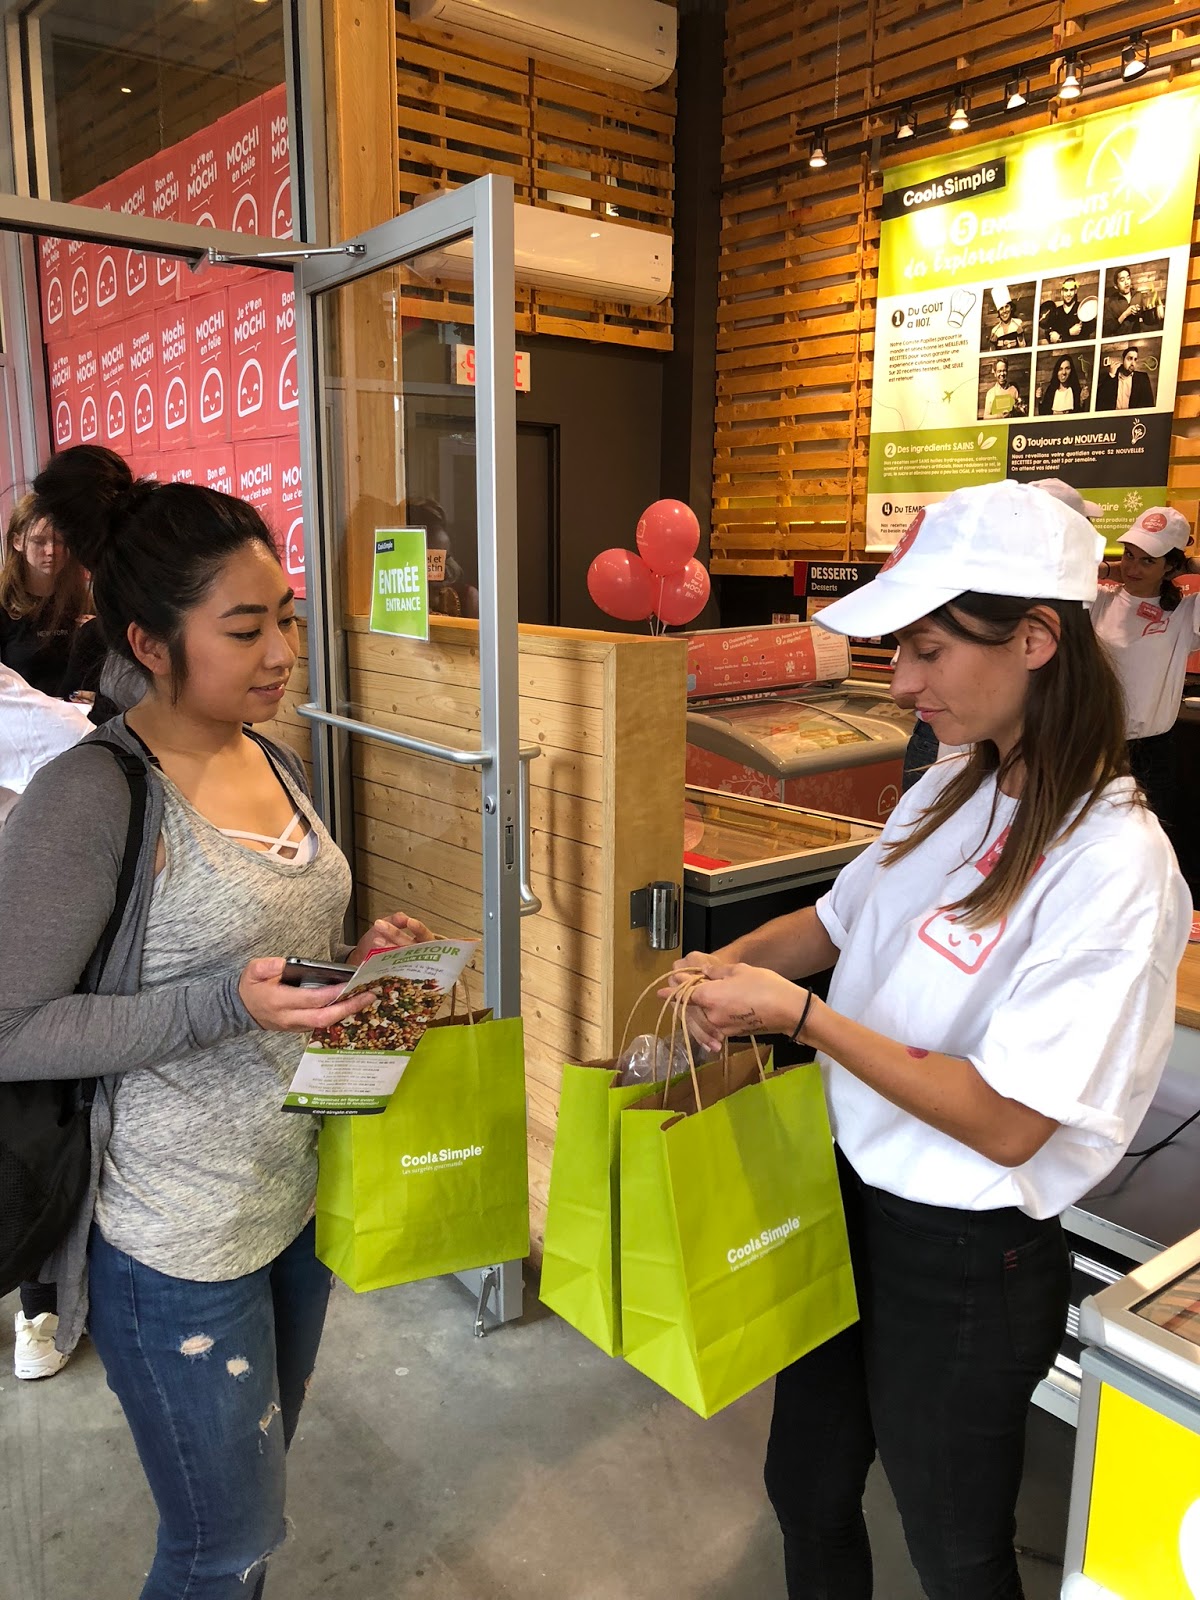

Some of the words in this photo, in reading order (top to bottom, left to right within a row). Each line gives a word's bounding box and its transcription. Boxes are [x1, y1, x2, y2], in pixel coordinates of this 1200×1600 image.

[226, 125, 259, 170] MOCHI
[154, 179, 166, 192] Bon
[166, 170, 174, 183] en
[188, 162, 218, 201] MOCHI
[232, 170, 240, 183] en
[240, 156, 256, 176] folie
[152, 180, 179, 217] MOCHI
[196, 310, 225, 343] MOCHI
[234, 309, 266, 345] MOCHI
[237, 308, 244, 321] Je
[162, 317, 185, 347] Mochi
[102, 342, 124, 370] MOCHI
[130, 342, 154, 372] MOCHI
[162, 338, 186, 365] MOCHI
[200, 344, 208, 356] en
[208, 334, 222, 352] folie
[52, 366, 71, 390] MOCHI
[76, 359, 97, 385] MOCHI
[953, 442, 974, 450] SAINS
[1027, 437, 1061, 447] Toujours
[1062, 436, 1073, 445] du
[1074, 433, 1116, 444] NOUVEAU
[207, 468, 217, 480] Bon
[217, 466, 226, 476] en
[240, 463, 272, 491] MOCHI
[250, 490, 261, 500] c'est
[261, 486, 272, 497] bon
[282, 492, 293, 502] Que
[379, 562, 420, 594] ENTRÉE
[811, 566, 858, 581] DESSERTS
[811, 582, 838, 592] Desserts
[386, 596, 421, 612] ENTRANCE
[405, 946, 460, 956] RETOUR
